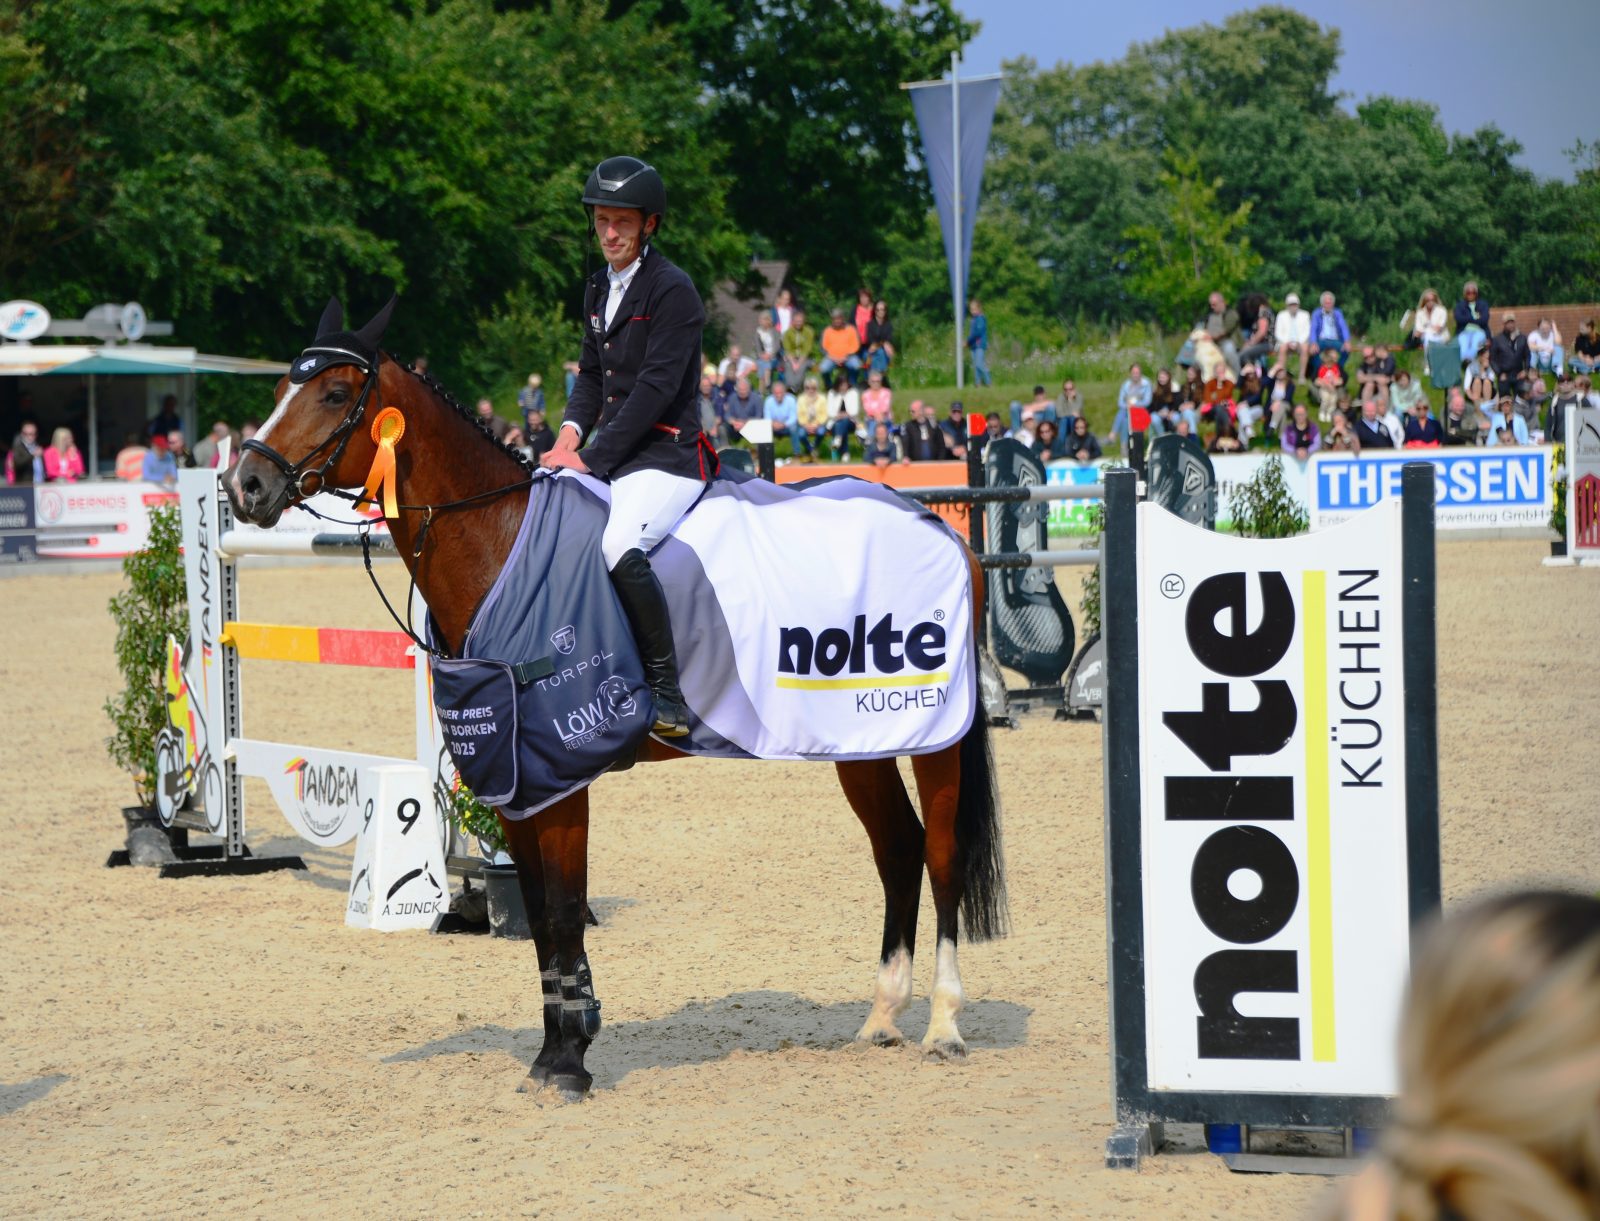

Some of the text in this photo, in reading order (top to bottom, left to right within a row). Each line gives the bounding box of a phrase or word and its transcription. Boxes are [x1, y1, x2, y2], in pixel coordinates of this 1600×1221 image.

[1320, 458, 1538, 505] THESSEN
[1436, 511, 1497, 523] erwertung
[536, 650, 614, 692] TORPOL
[1331, 569, 1382, 787] KÜCHEN
[463, 706, 494, 720] PREIS
[856, 686, 949, 713] KÜCHEN
[451, 721, 498, 737] BORKEN
[553, 698, 604, 741] LÖW
[564, 720, 612, 752] REITSPORT
[451, 741, 476, 756] 2025
[288, 758, 361, 808] TANDEM
[363, 798, 374, 834] 9
[397, 797, 421, 836] 9
